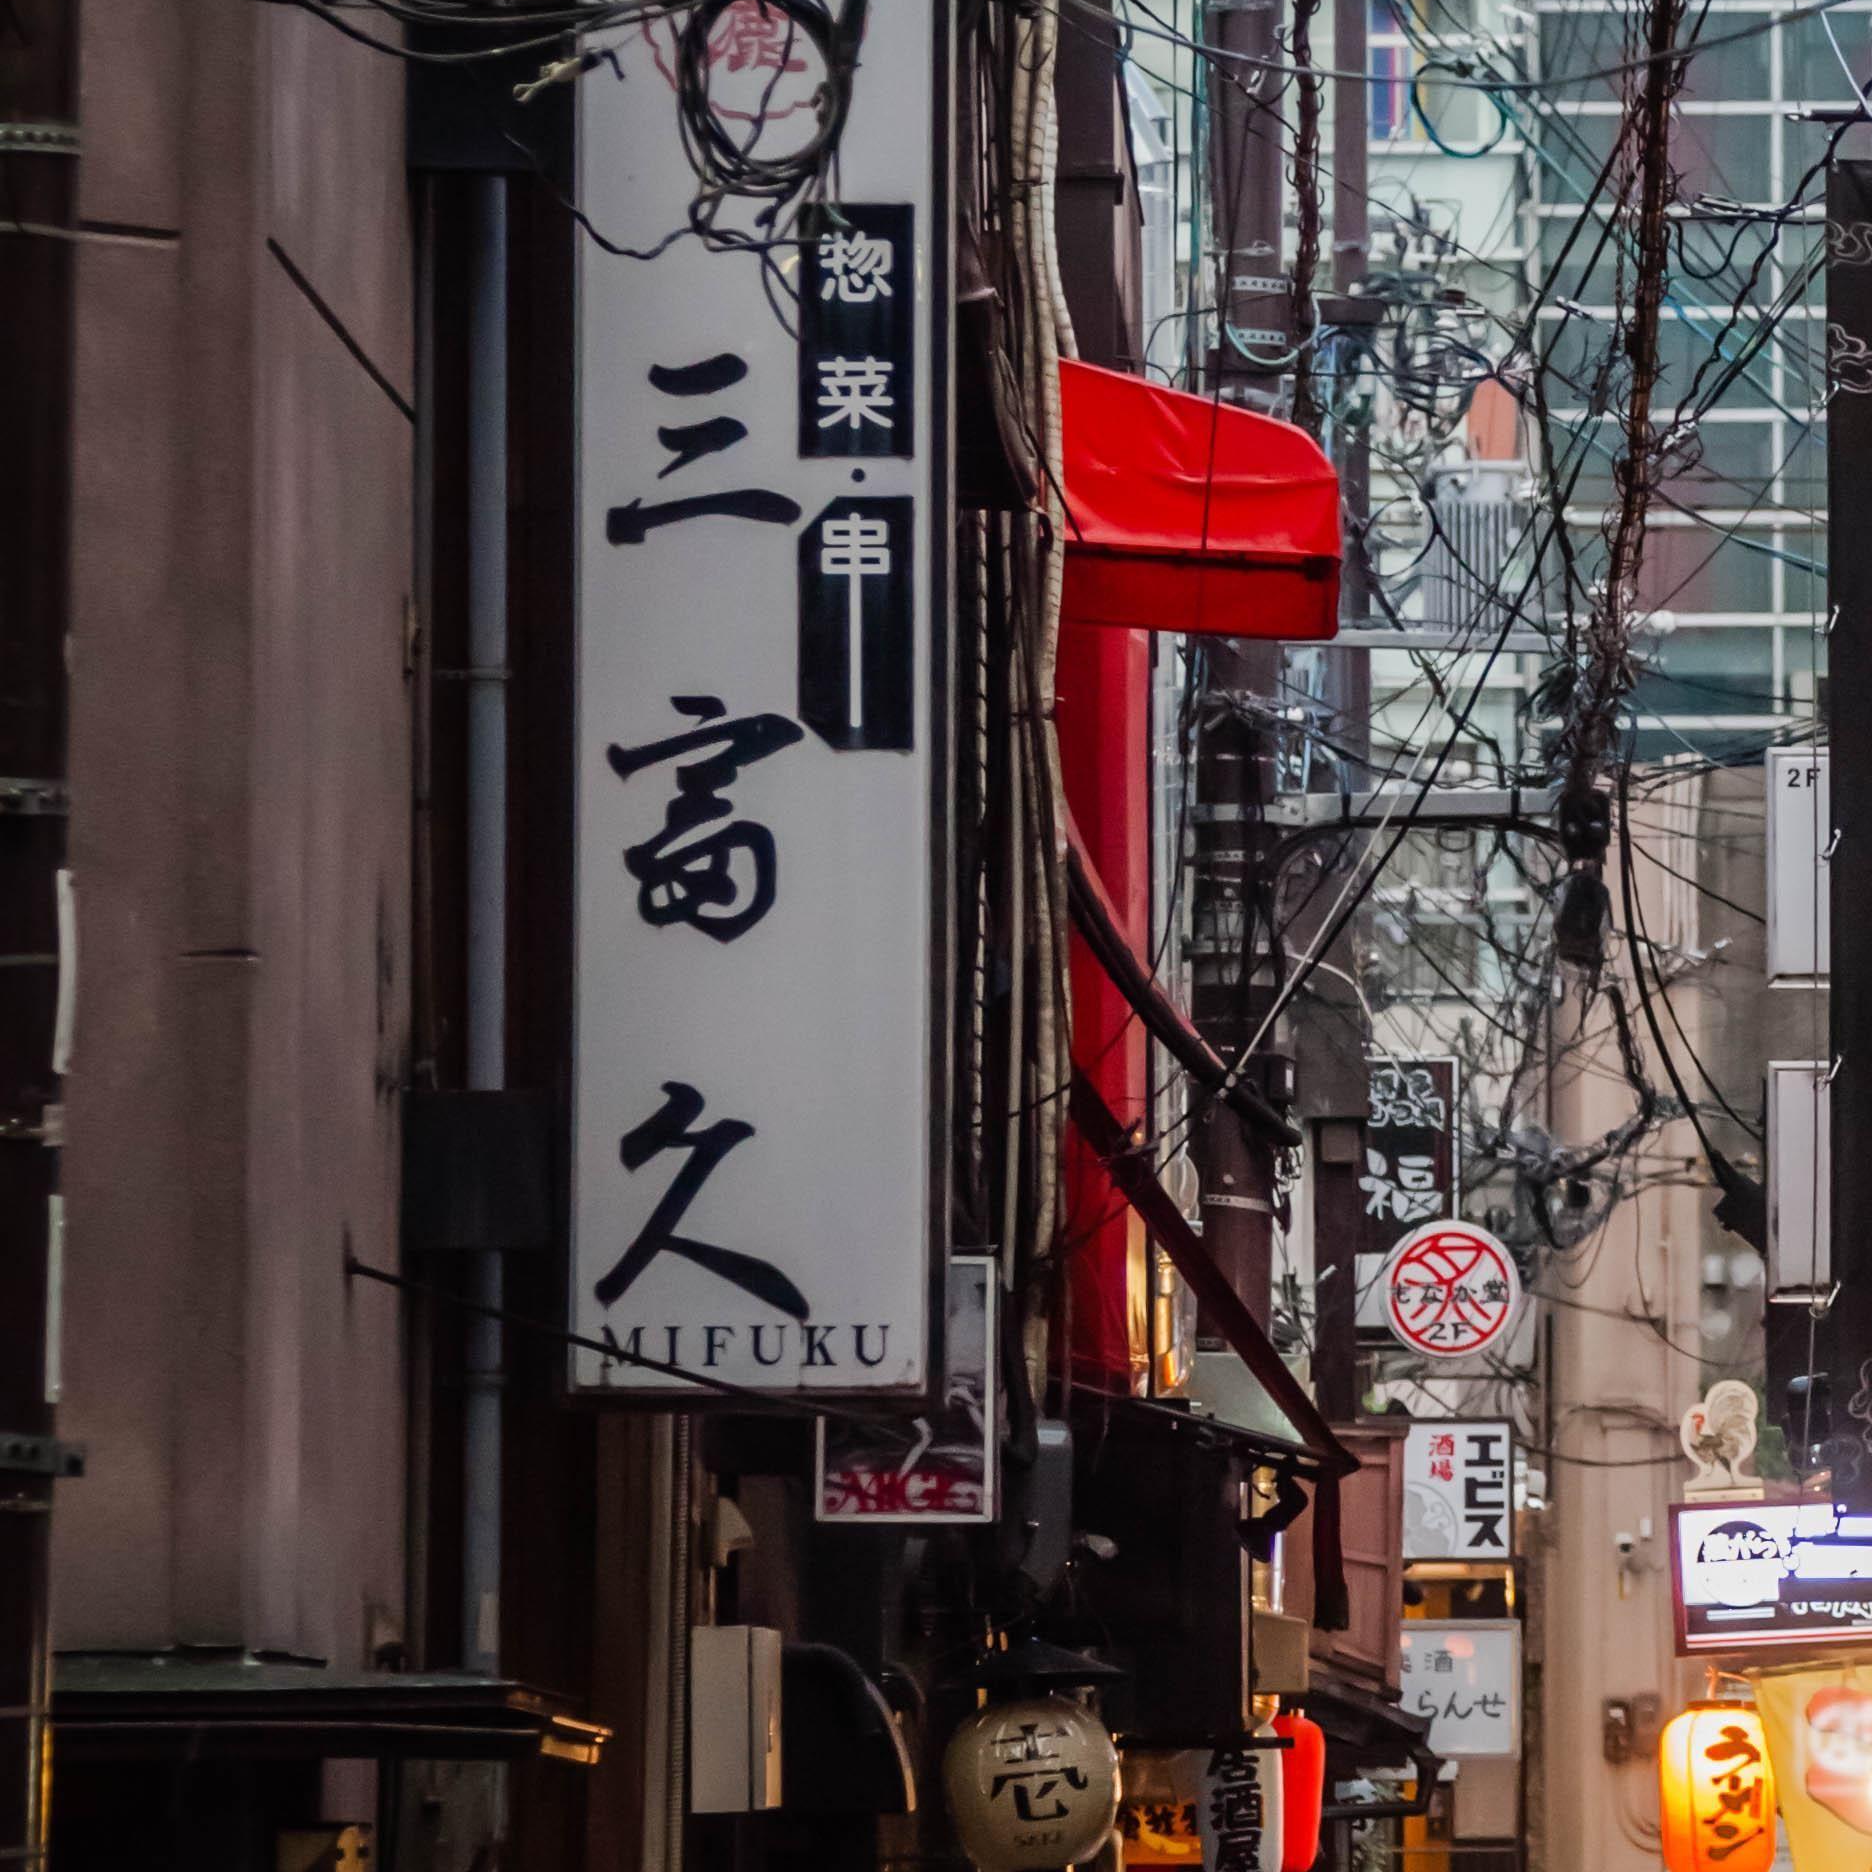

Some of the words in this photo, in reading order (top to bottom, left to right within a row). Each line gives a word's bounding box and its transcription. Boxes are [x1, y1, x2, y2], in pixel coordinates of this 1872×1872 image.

[1787, 768, 1821, 788] 2F
[596, 350, 810, 1318] 三富久
[599, 1323, 890, 1370] MIFUKU
[1428, 1321, 1470, 1342] 2F
[1463, 1435, 1505, 1548] エビス
[1702, 1726, 1766, 1862] ラーメン
